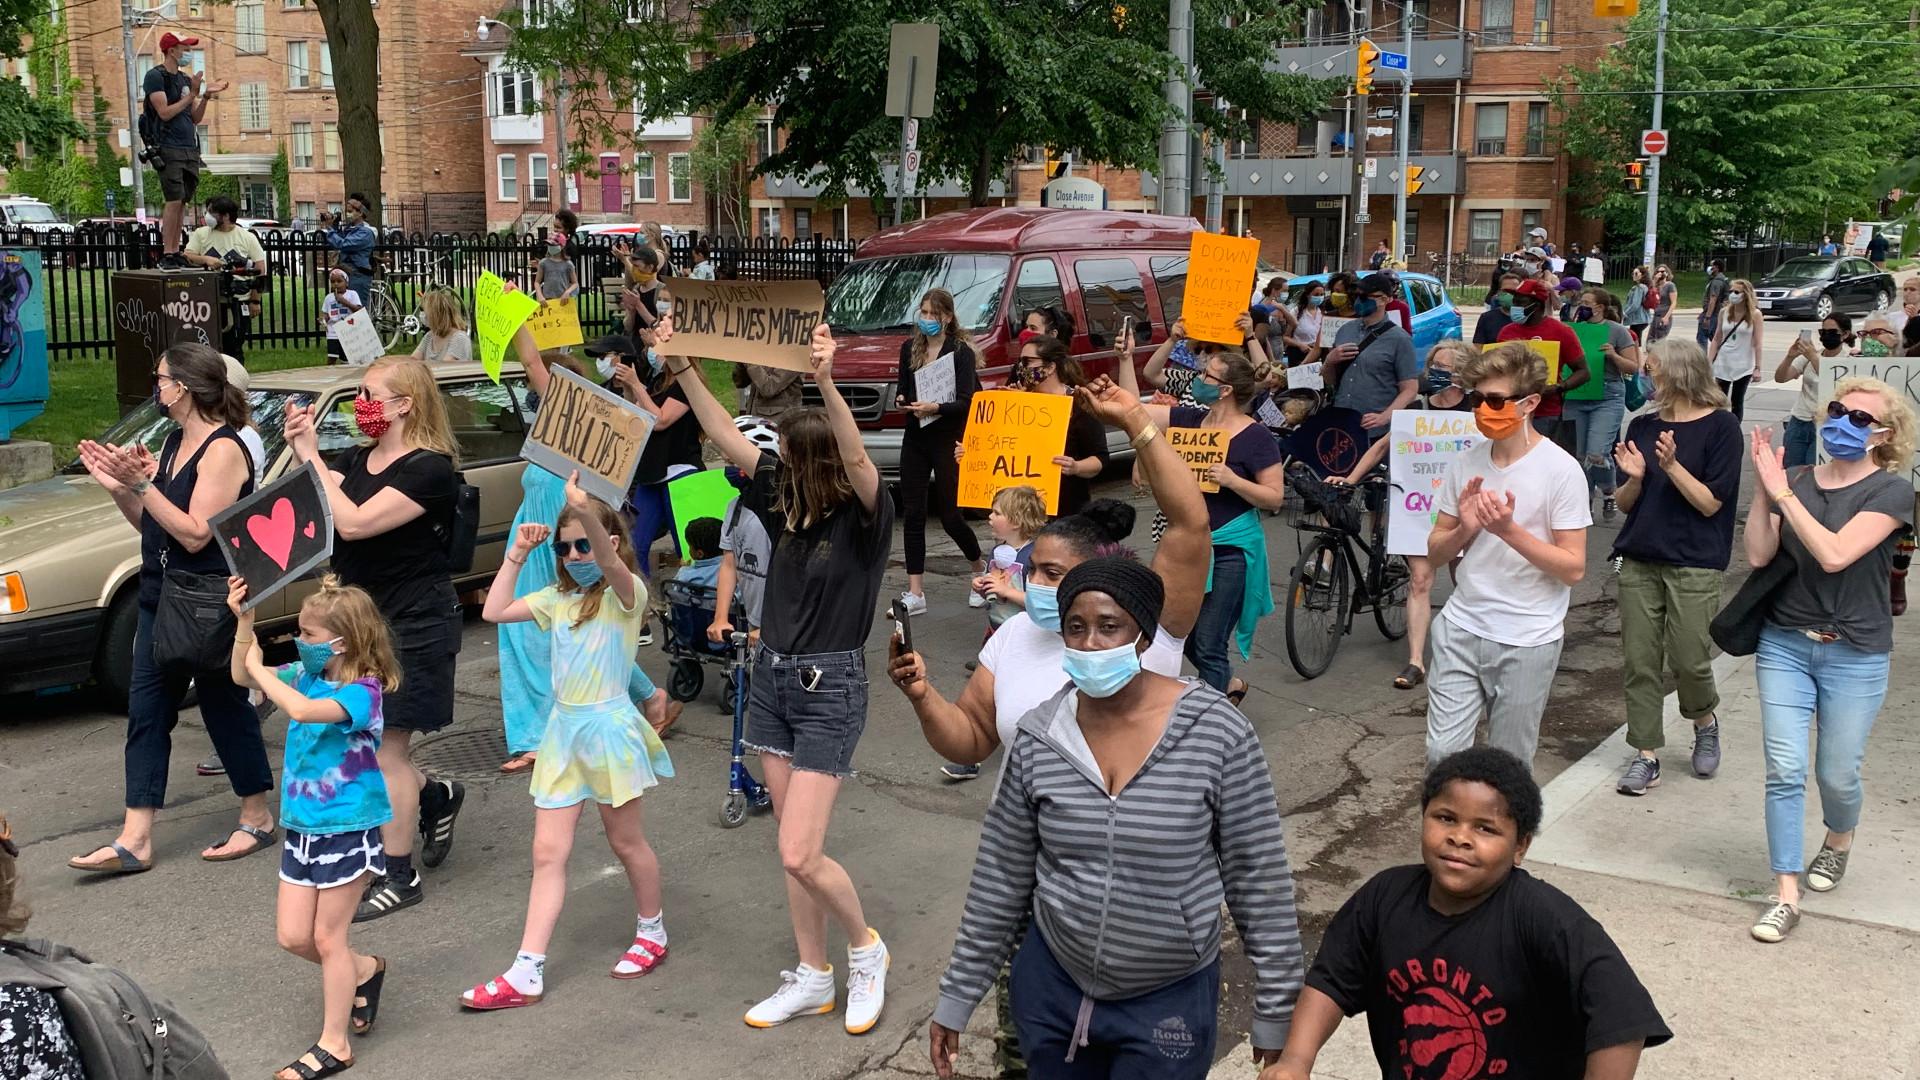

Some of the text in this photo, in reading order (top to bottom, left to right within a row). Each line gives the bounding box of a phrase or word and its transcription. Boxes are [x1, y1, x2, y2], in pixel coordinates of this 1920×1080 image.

[1056, 189, 1095, 202] Close Avenue
[1201, 244, 1251, 264] DOWN
[1193, 273, 1242, 292] RACIST
[705, 285, 769, 302] STUDENT
[673, 296, 819, 346] BLACK LIVES MATTER
[975, 400, 1052, 428] NO KIDS
[531, 373, 625, 477] BLACK LIVES
[1416, 416, 1477, 437] BLACK
[967, 434, 1018, 452] ARE SAFE
[1172, 432, 1221, 447] BLACK
[1397, 440, 1471, 454] STUDENTS
[1176, 450, 1223, 463] UDENTS
[992, 455, 1042, 478] ALL
[1412, 462, 1448, 475] STAFF
[963, 480, 980, 500] KIDS
[1386, 958, 1507, 1026] TORONTO
[1153, 1028, 1192, 1041] Roots
